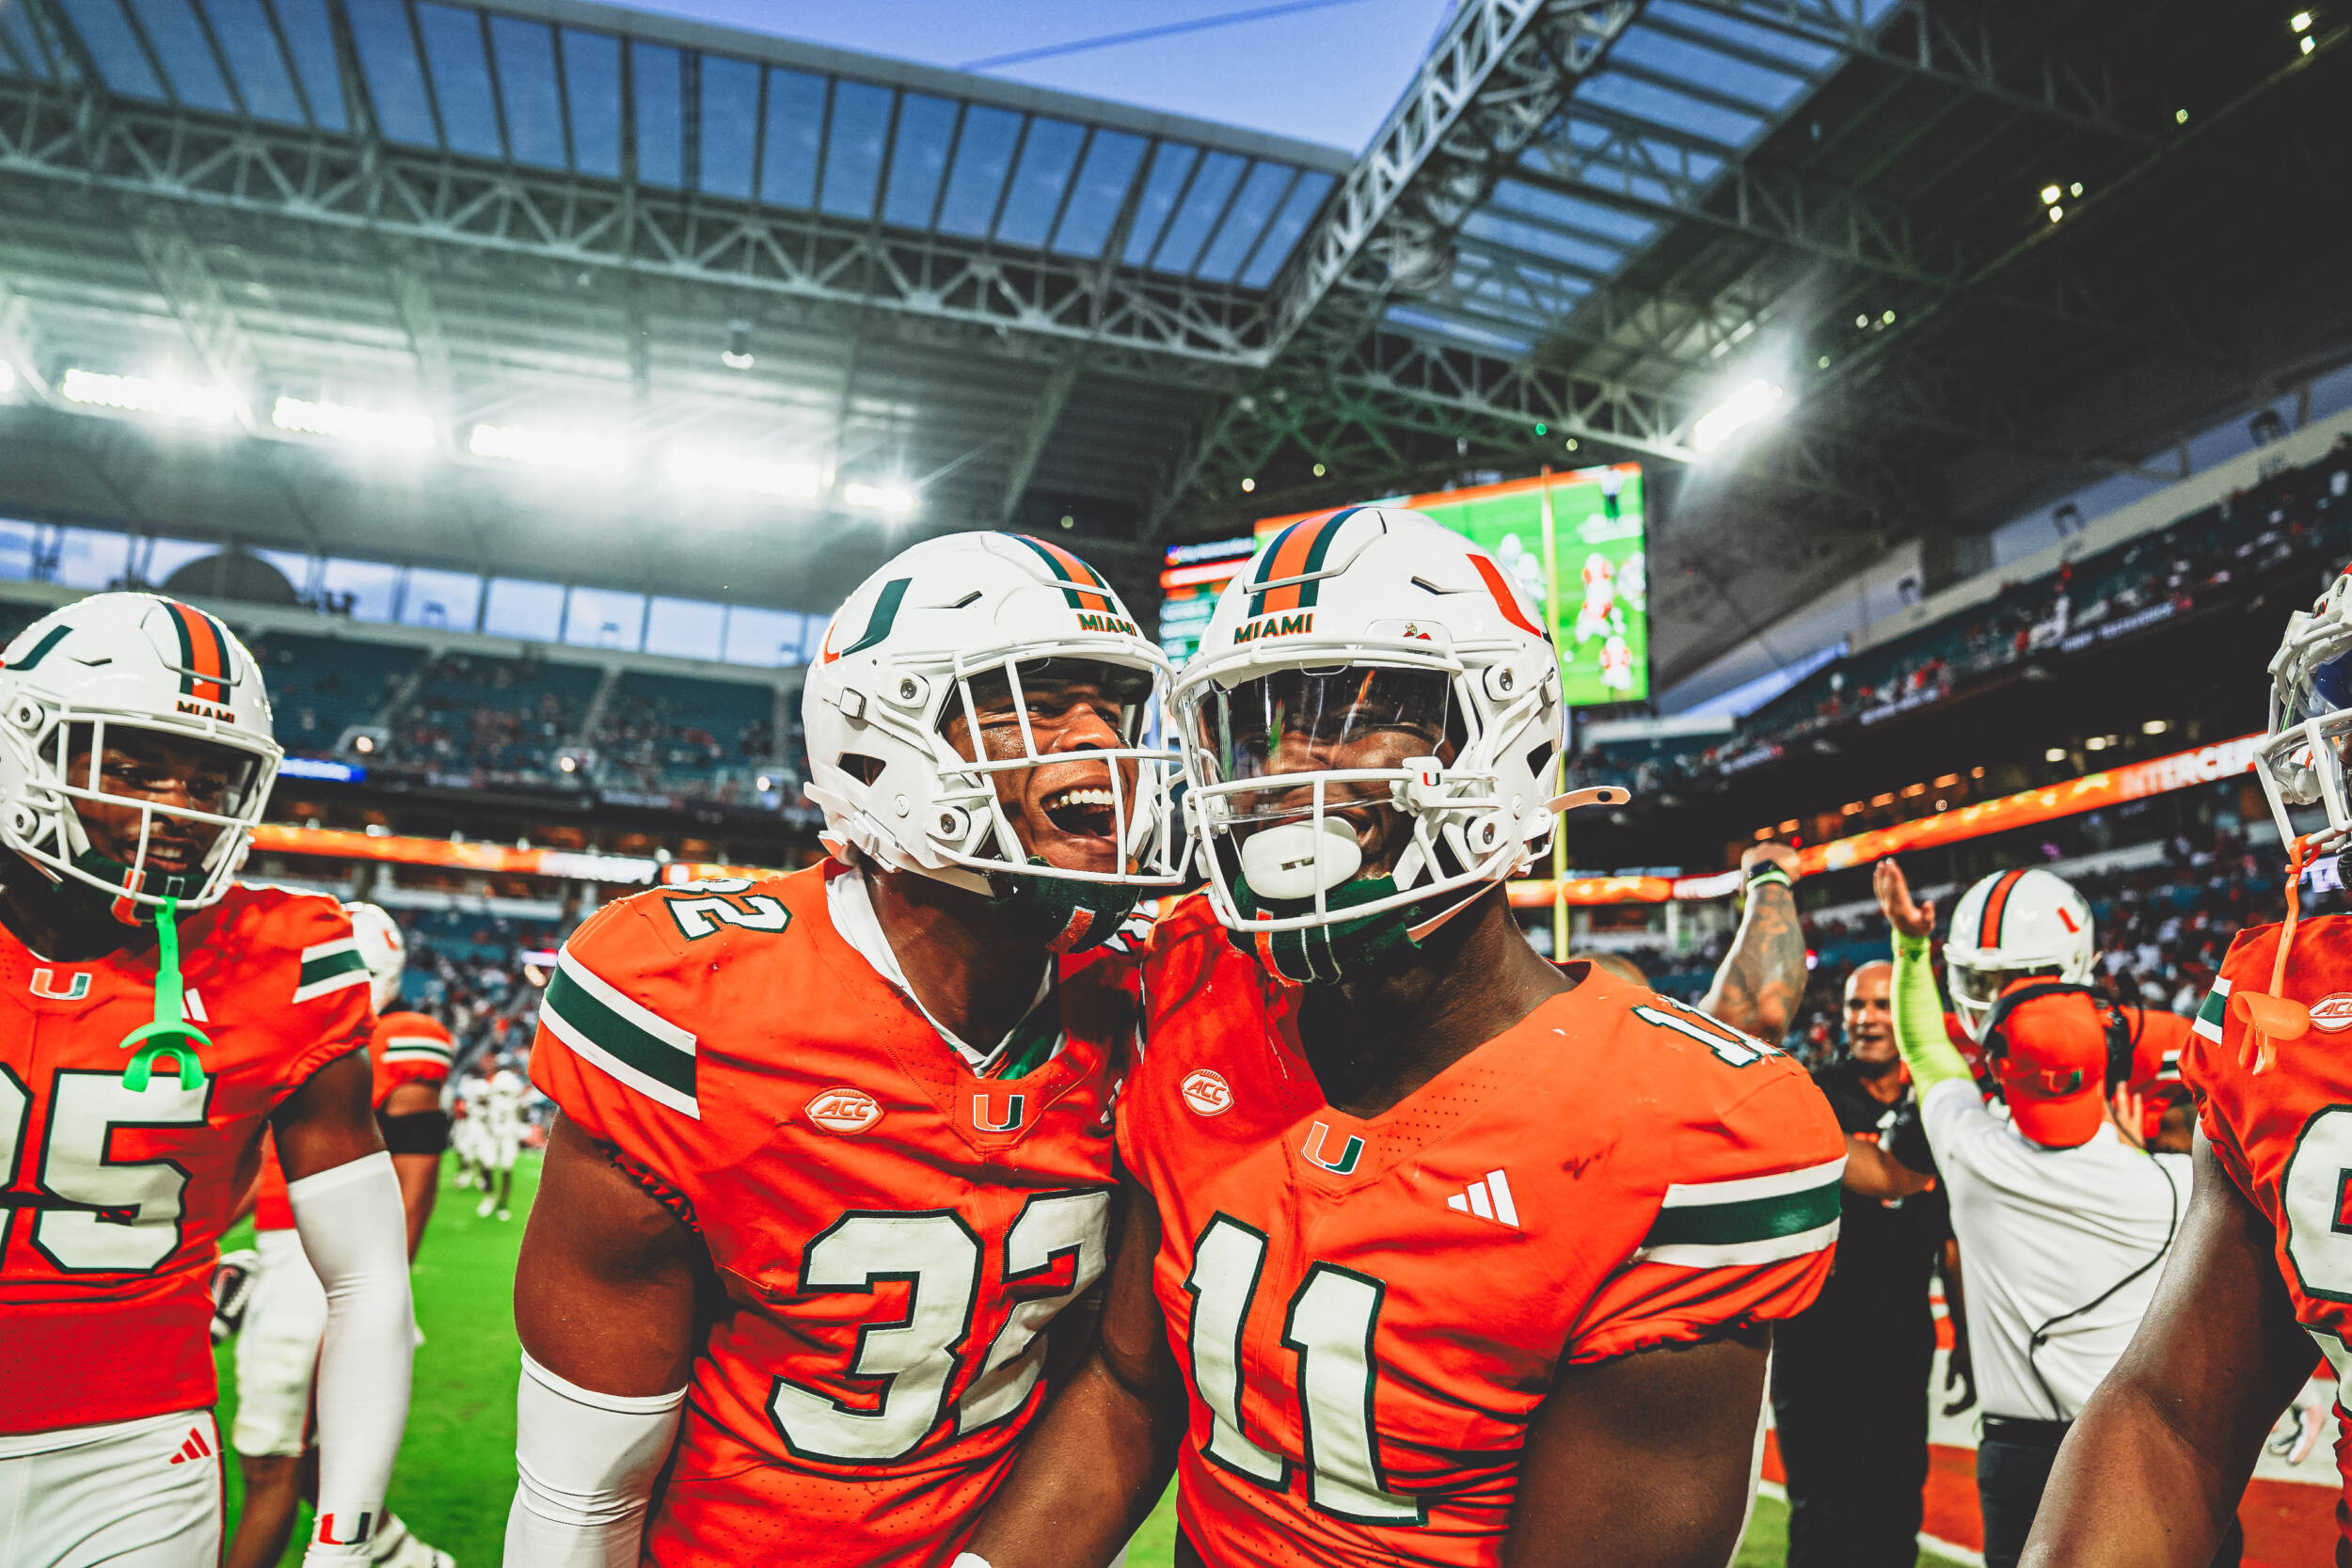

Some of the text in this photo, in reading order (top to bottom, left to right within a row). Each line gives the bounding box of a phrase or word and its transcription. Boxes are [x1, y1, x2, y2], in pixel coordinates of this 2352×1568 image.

[1076, 613, 1137, 637] MIAMI
[1233, 612, 1314, 645] MIAMI
[176, 700, 234, 723] MIAMI
[1422, 771, 1441, 787] U
[2120, 733, 2268, 800] INTERCEP
[29, 968, 92, 1001] U
[2313, 1001, 2352, 1016] AC
[1187, 1080, 1228, 1102] ACC
[817, 1099, 873, 1118] ACC
[972, 1094, 1025, 1132] U
[1301, 1121, 1366, 1176] U
[765, 1186, 1112, 1466] 32
[1183, 1210, 1429, 1526] 11
[318, 1512, 372, 1545] U
